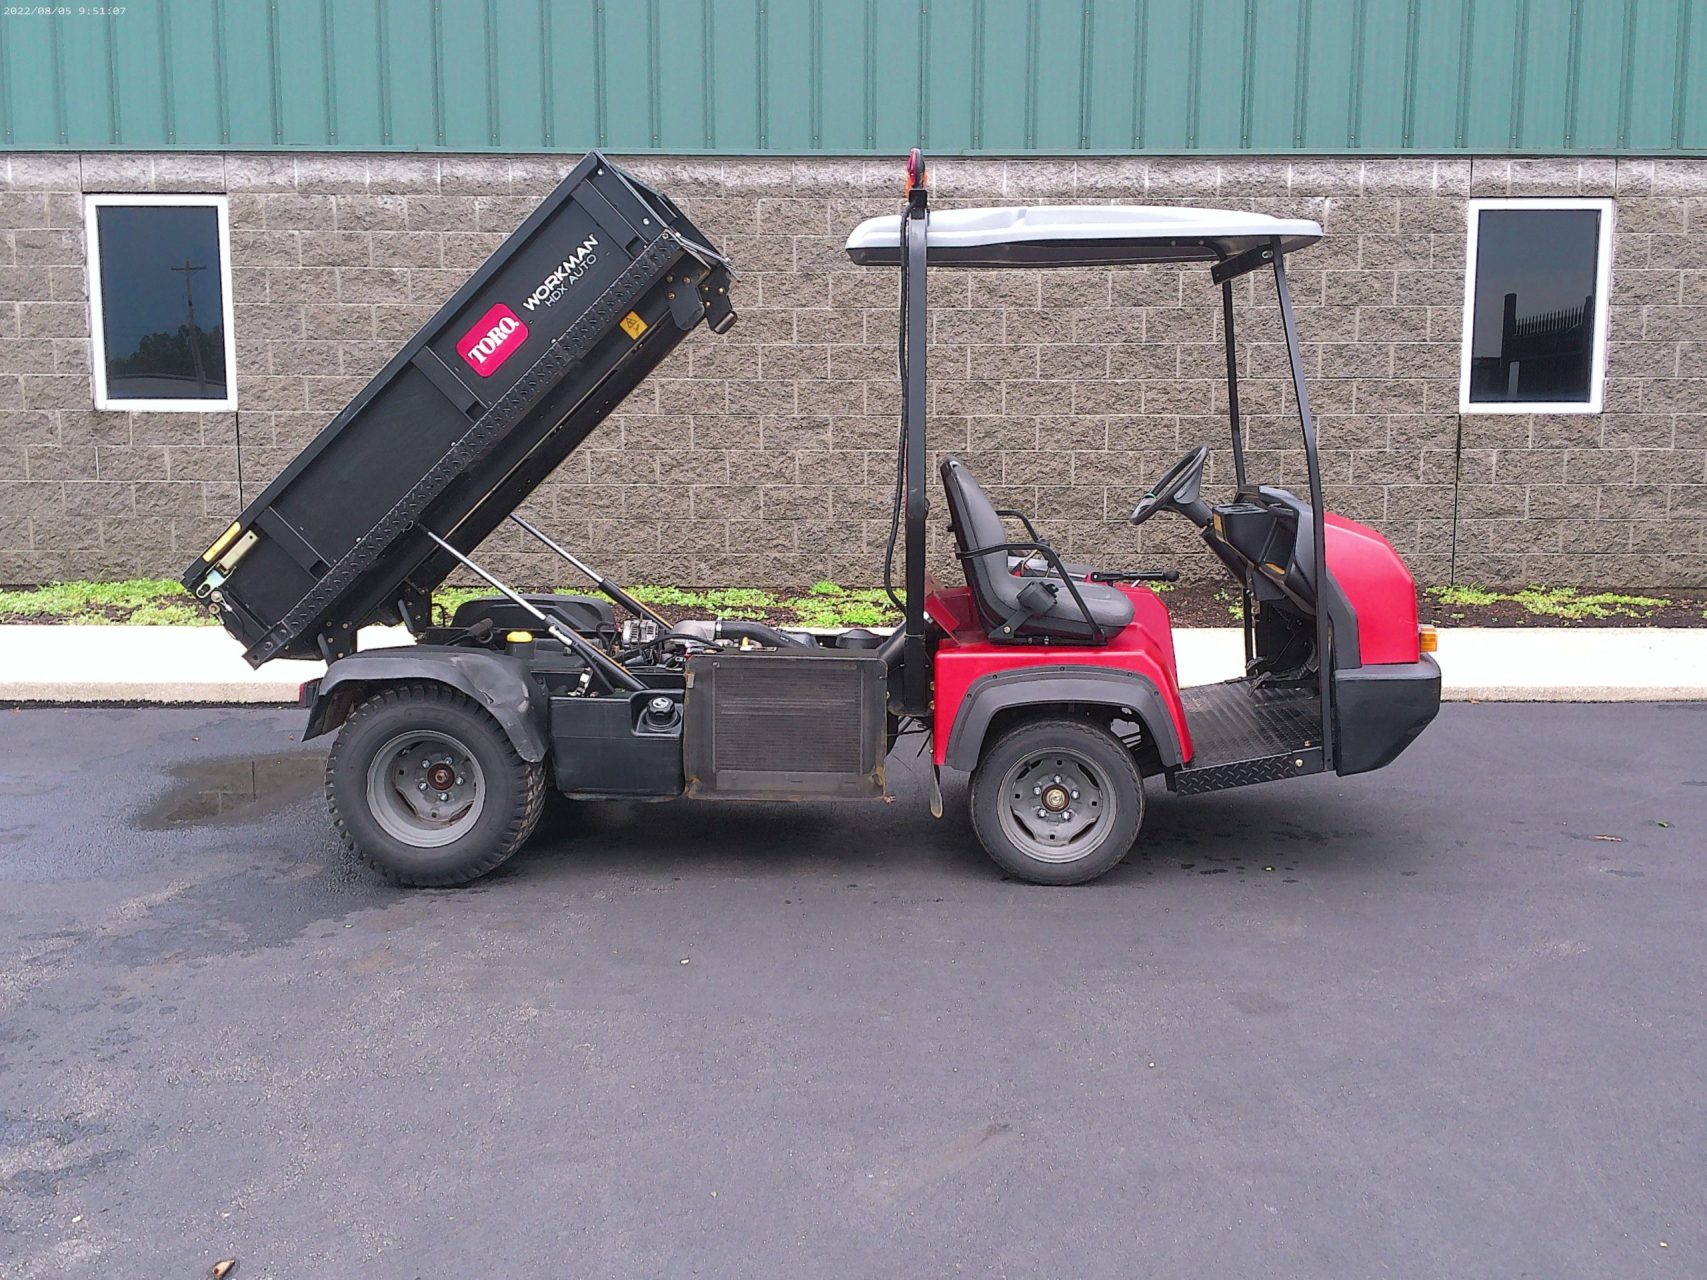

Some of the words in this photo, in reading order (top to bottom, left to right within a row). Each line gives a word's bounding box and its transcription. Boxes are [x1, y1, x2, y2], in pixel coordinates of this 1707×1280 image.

[523, 234, 599, 311] WORKMAN
[544, 286, 568, 308] HDX
[568, 254, 597, 286] AUTO
[467, 316, 517, 364] TORO
